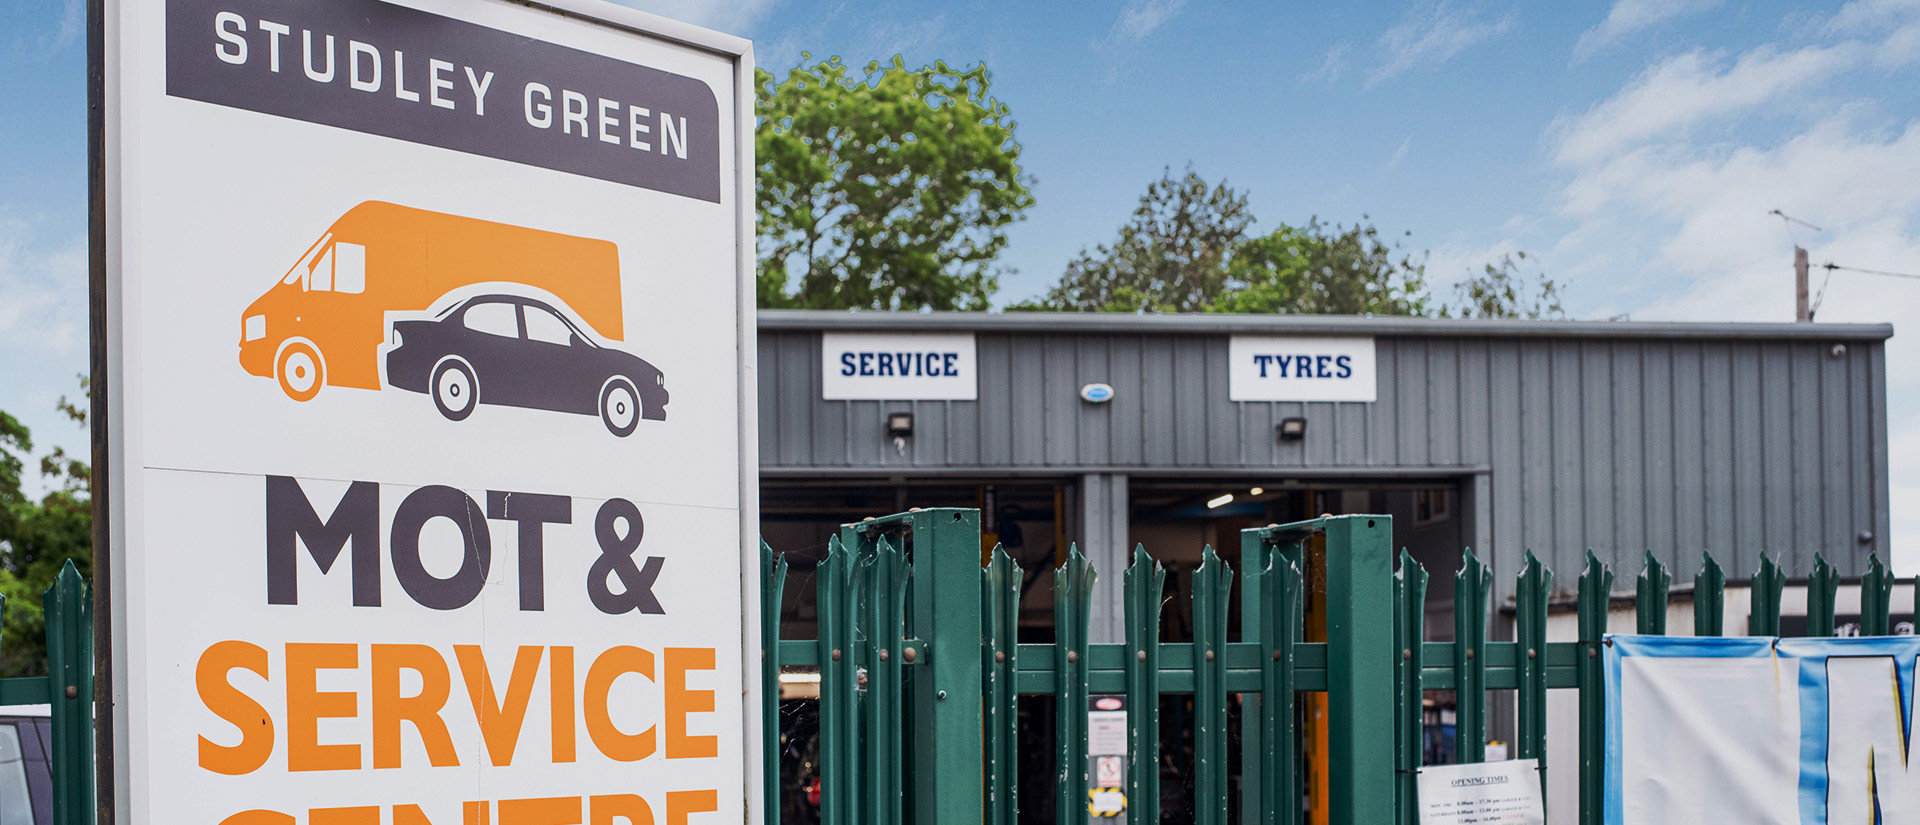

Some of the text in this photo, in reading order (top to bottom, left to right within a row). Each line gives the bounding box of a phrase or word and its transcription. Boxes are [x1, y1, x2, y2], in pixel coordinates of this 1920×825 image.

[215, 11, 689, 160] STUDLEY GREEN
[840, 351, 959, 378] SERVICE
[1253, 354, 1352, 379] TYRES
[265, 474, 667, 615] MOT &
[195, 640, 718, 776] SERVICE
[1451, 775, 1509, 787] OPENING TIMES
